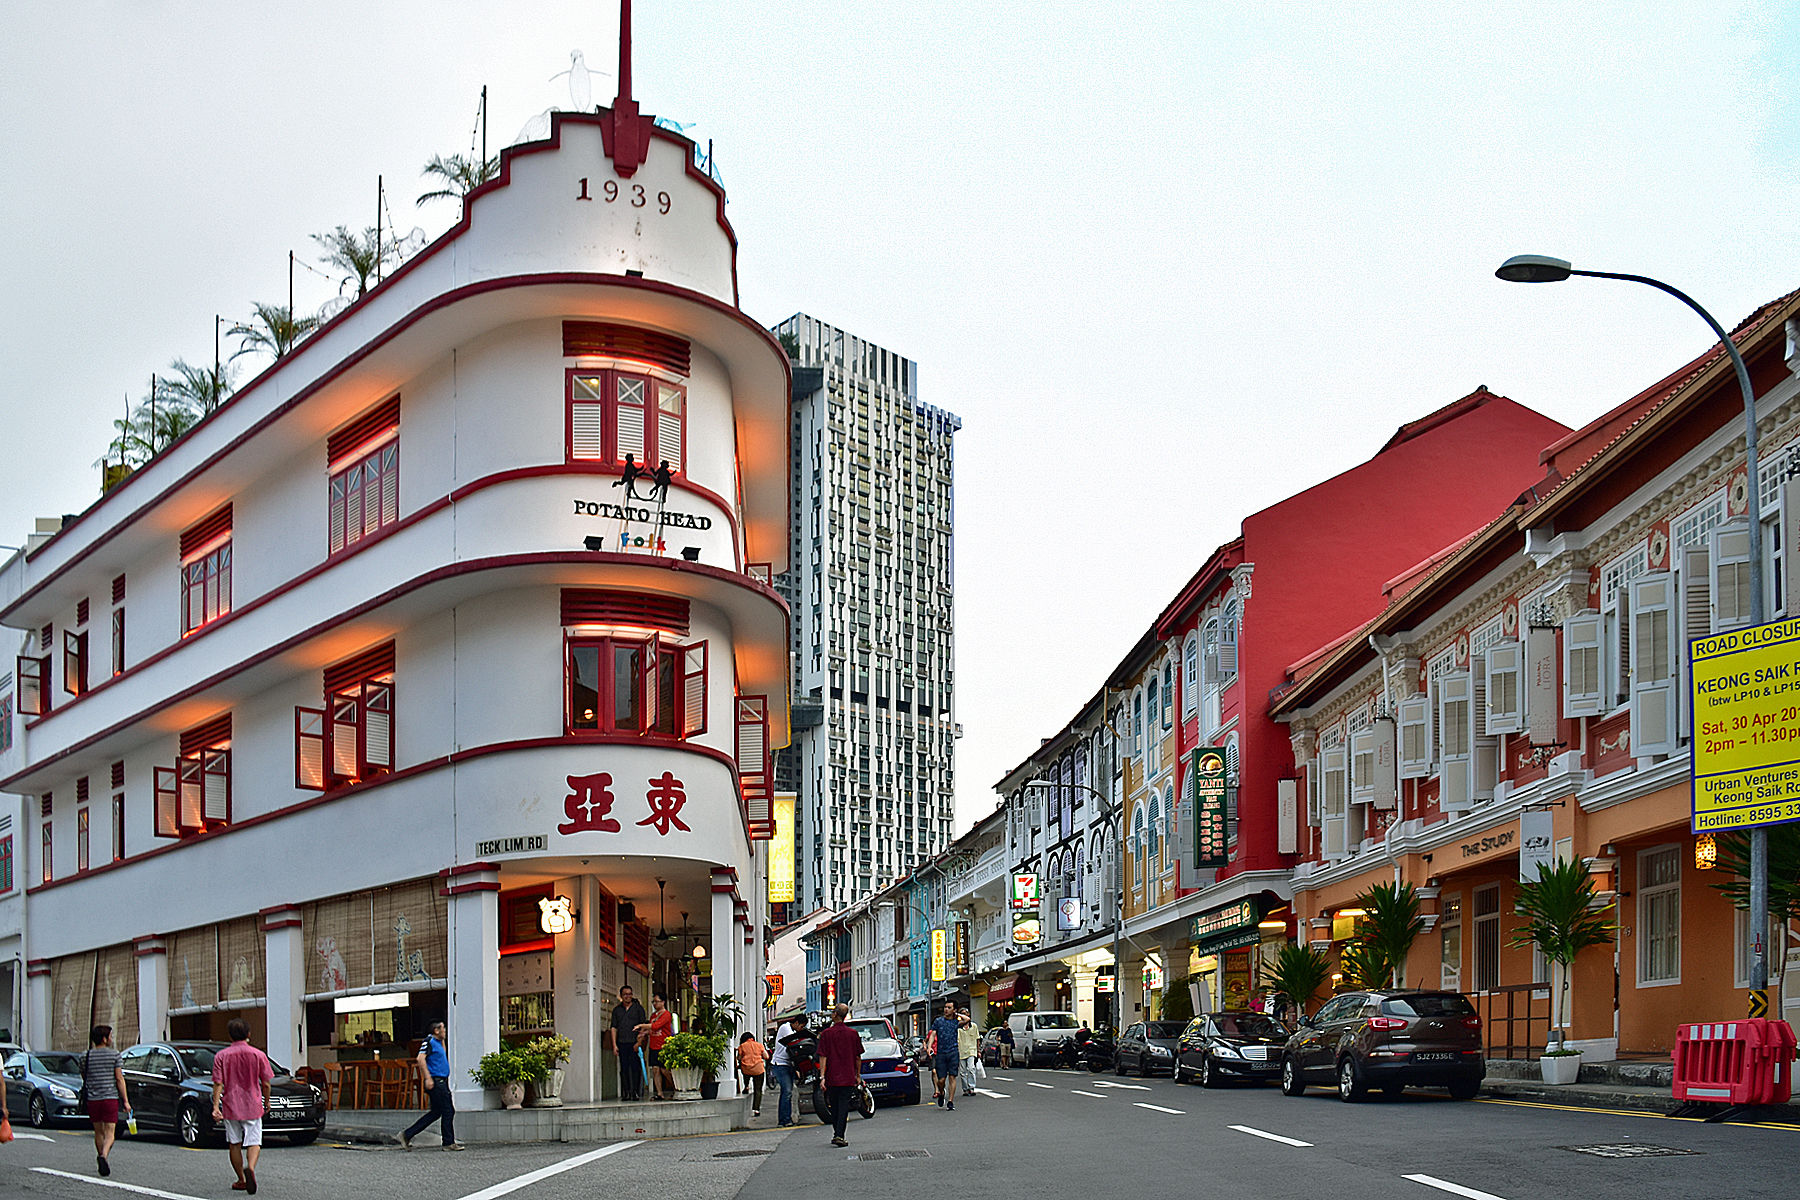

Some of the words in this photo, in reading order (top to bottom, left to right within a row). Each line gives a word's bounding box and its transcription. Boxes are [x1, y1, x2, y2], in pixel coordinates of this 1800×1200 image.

[575, 177, 672, 215] 1939
[574, 500, 650, 522] POTATO
[660, 511, 712, 530] HEAD
[1696, 635, 1738, 656] ROAD
[1697, 672, 1750, 694] KEONG
[1754, 663, 1790, 683] SAIK
[1708, 696, 1731, 707] (btw
[1734, 689, 1760, 702] LP10
[1763, 687, 1771, 696] &
[1702, 720, 1728, 735] Sat,
[1732, 715, 1747, 730] 30
[1752, 712, 1777, 728] Apr
[1705, 739, 1735, 755] 2pm
[1705, 779, 1740, 792] Urban
[1744, 770, 1798, 786] Ventures
[1714, 791, 1753, 804] Keong
[1756, 785, 1782, 798] Saik
[1699, 814, 1745, 827] Hotline:
[1749, 806, 1782, 821] 8595
[479, 841, 500, 855] TECK
[504, 838, 523, 852] LIM
[528, 836, 542, 850] RD
[1460, 842, 1480, 858] THE
[1481, 830, 1515, 852] STUDY
